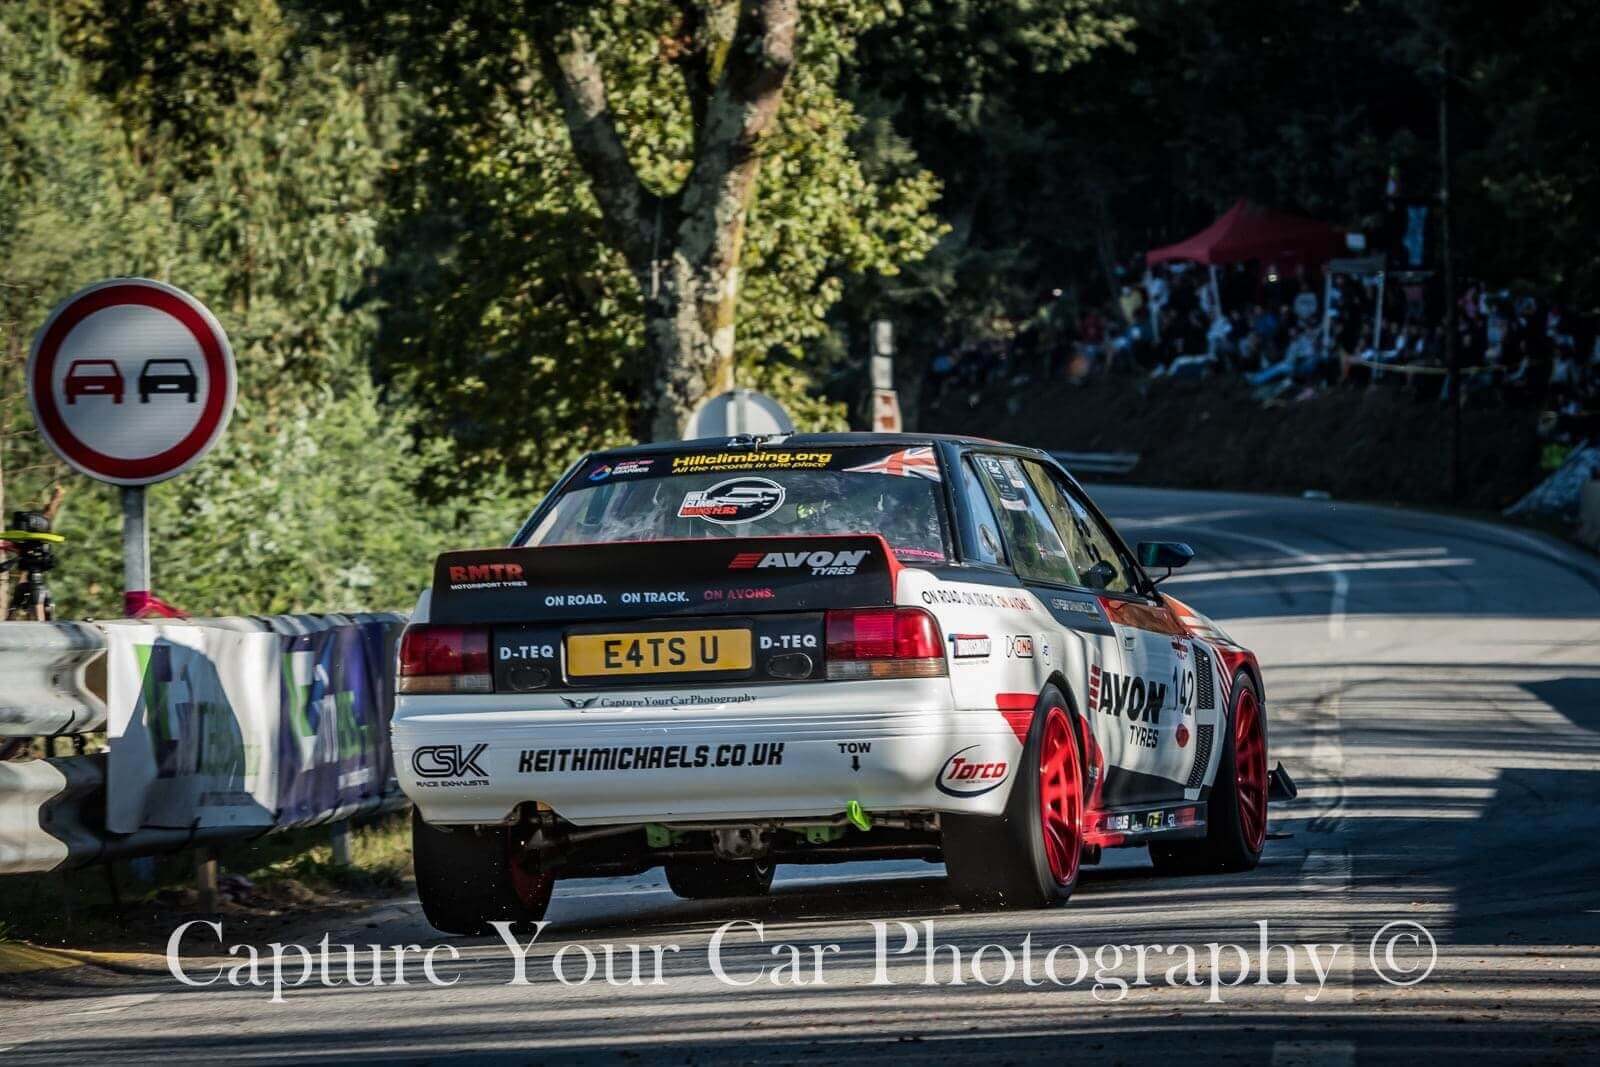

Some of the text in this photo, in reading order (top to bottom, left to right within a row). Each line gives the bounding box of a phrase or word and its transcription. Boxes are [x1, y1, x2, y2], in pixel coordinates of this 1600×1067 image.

[671, 465, 688, 474] All
[690, 464, 708, 473] the
[711, 463, 754, 471] records
[791, 461, 826, 470] place
[672, 451, 833, 468] Hillclimbing.org
[757, 550, 866, 568] AVON
[449, 563, 523, 582] BMTR
[811, 566, 857, 577] TYRES
[544, 587, 776, 607] ON ROAD. ON TRACK. ON AVONS.
[759, 634, 818, 649] D-TEQ
[499, 645, 555, 660] D-TEQ
[604, 635, 719, 669] E4TS U
[600, 692, 758, 709] CaptureYourCarPhotography
[1098, 671, 1166, 724] AVON
[1171, 666, 1195, 716] 142
[1129, 725, 1159, 748] TYRES
[517, 742, 785, 774] KEITHMICHAELS.CO.UK
[837, 742, 872, 755] TOW
[411, 743, 490, 778] CSK
[946, 757, 1008, 780] Torco
